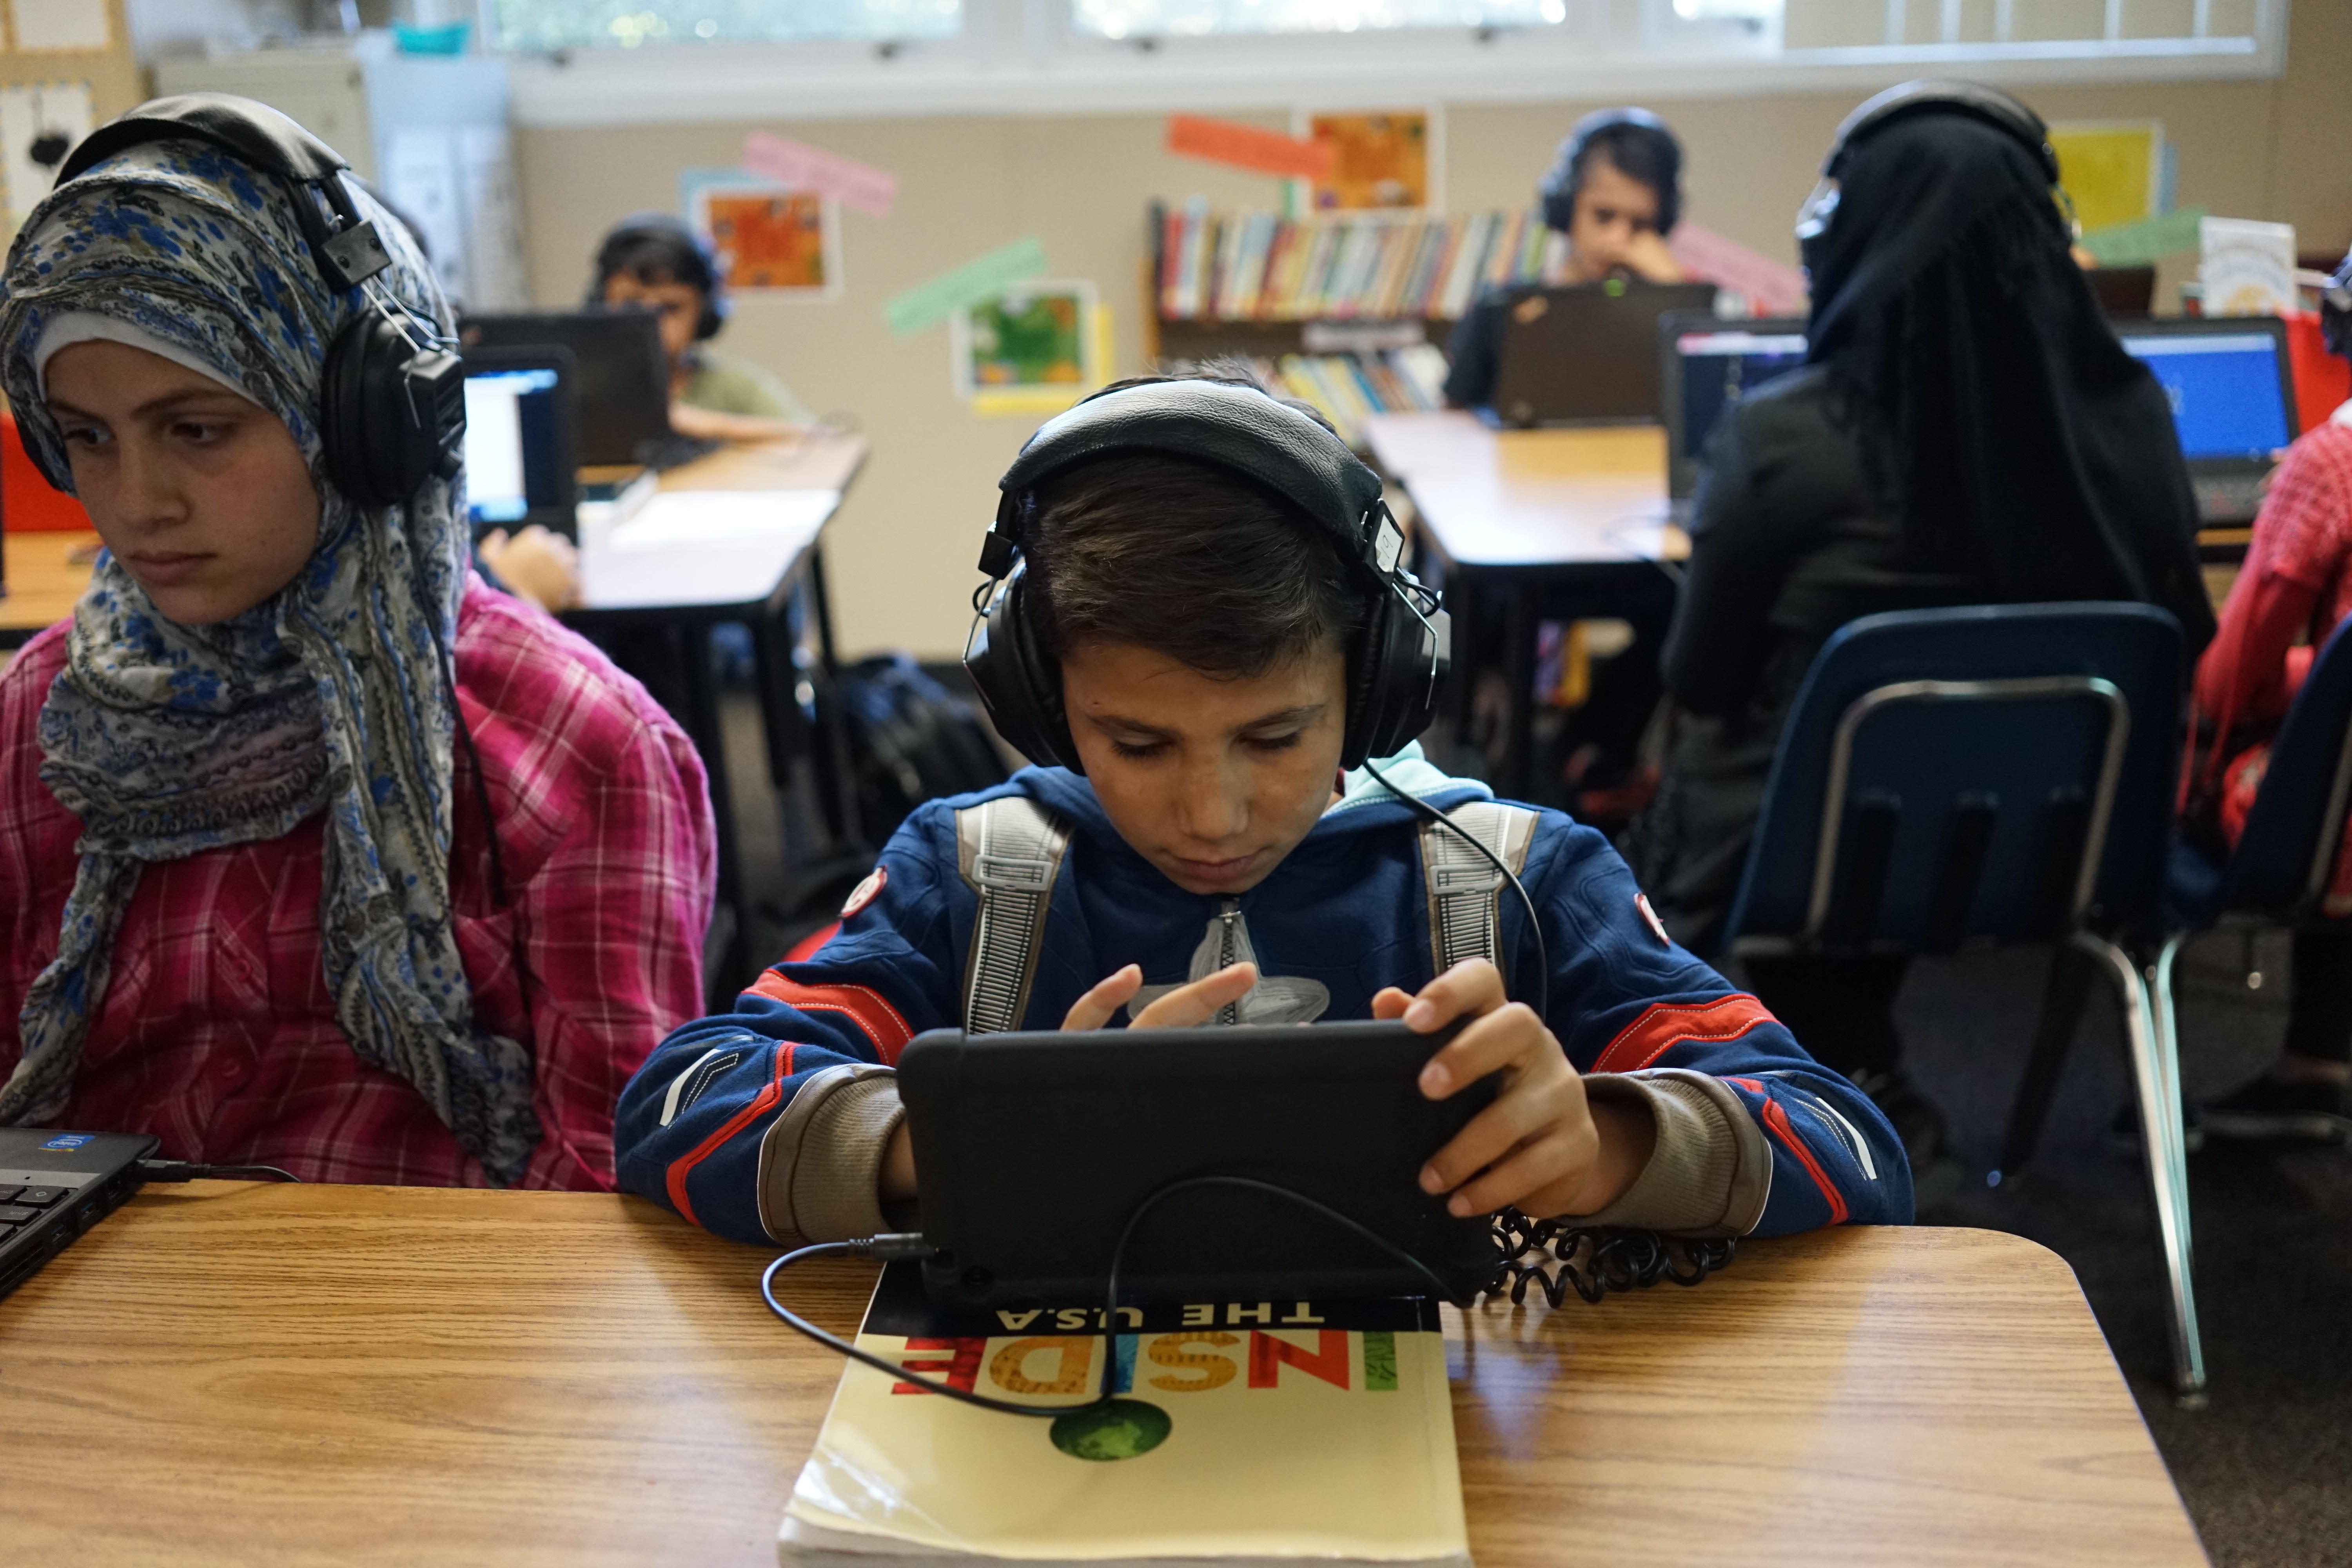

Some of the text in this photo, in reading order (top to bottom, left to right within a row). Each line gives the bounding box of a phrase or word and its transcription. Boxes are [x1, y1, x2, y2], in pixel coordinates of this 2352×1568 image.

[1381, 534, 1393, 559] 19
[1182, 1303, 1326, 1326] THE
[892, 1330, 1398, 1396] INSIDE
